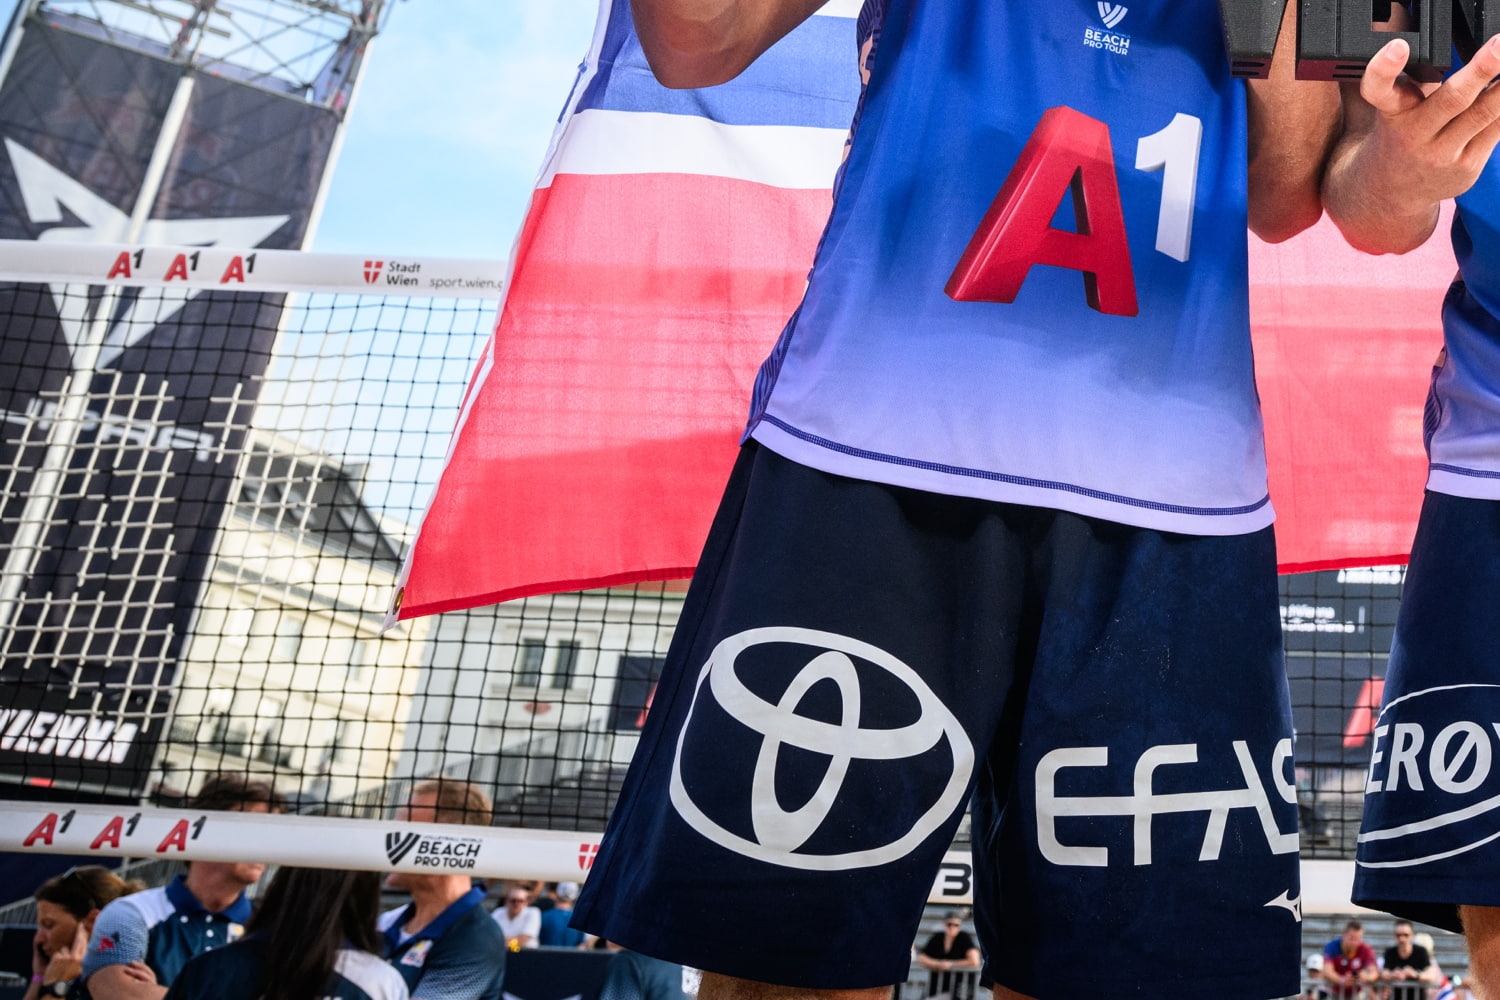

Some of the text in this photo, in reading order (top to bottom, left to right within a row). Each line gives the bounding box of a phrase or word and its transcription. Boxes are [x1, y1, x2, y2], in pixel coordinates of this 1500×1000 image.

[1083, 38, 1128, 56] PRO TOUR
[1084, 28, 1130, 48] BEACH
[944, 105, 1202, 317] A1
[107, 248, 144, 279] A1
[163, 250, 200, 281] A1
[220, 253, 256, 284] A1
[388, 261, 421, 273] Stadt
[386, 274, 418, 286] Wien
[23, 809, 76, 847] A1
[89, 812, 142, 849] A1
[156, 815, 207, 853] A1
[414, 856, 476, 869] PRO TOUR
[418, 841, 480, 857] BEACH
